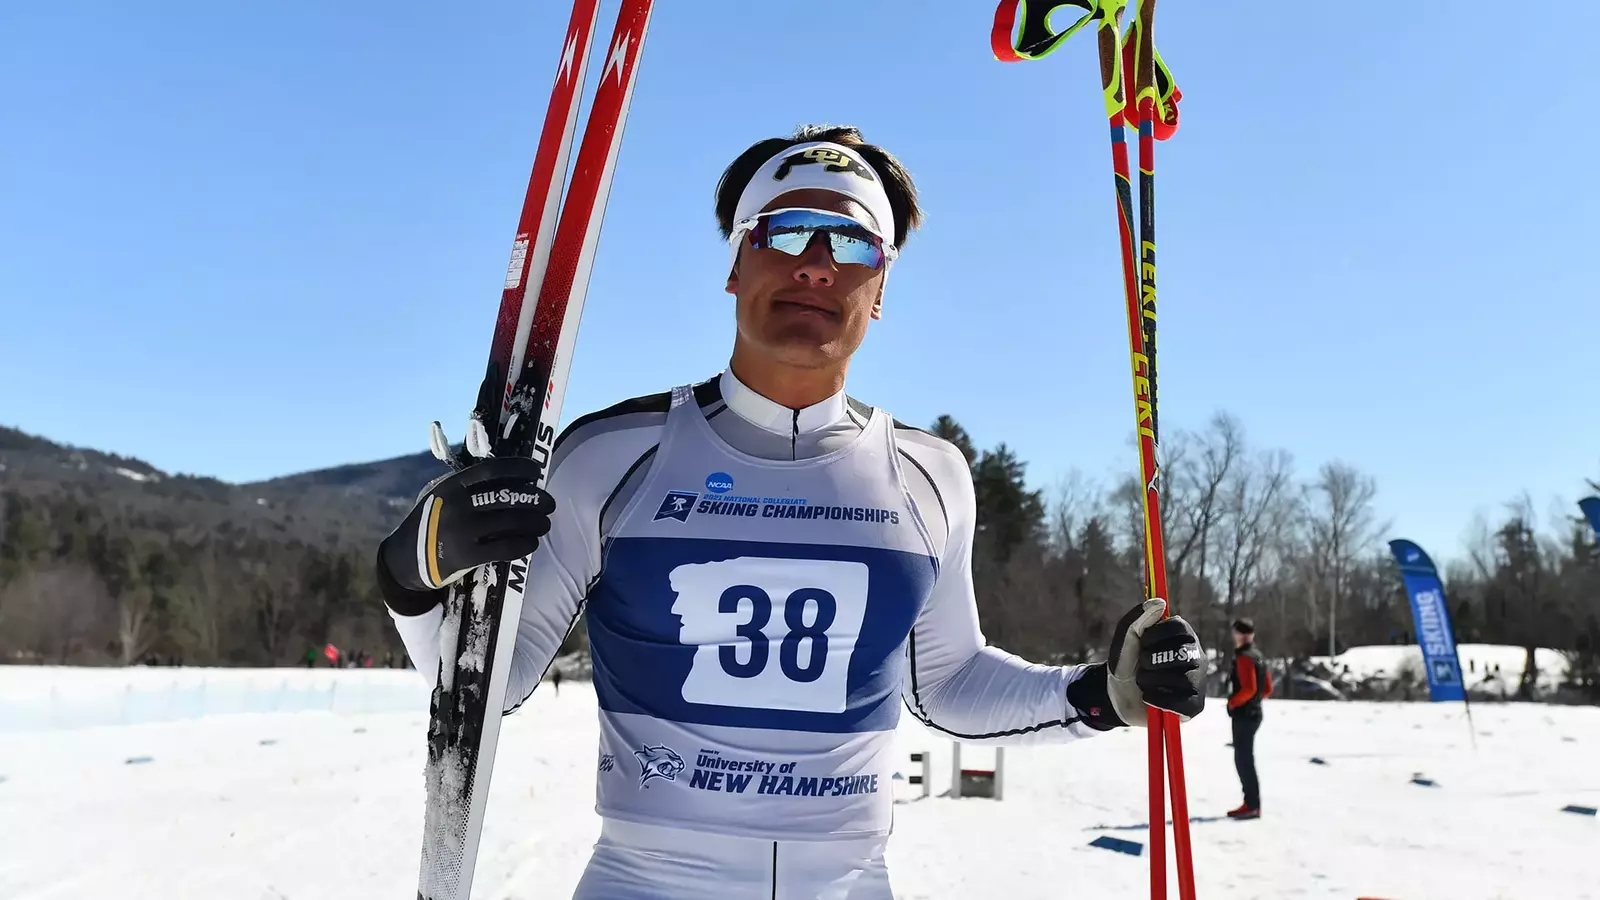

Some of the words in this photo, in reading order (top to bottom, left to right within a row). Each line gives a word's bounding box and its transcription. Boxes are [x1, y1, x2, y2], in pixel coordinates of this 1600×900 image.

[1141, 240, 1157, 322] LEKI
[1133, 351, 1155, 439] LEKI
[707, 480, 732, 489] NCAA
[696, 500, 758, 517] SKIING
[761, 504, 900, 525] CHAMPIONSHIPS
[718, 584, 837, 683] 38
[1415, 591, 1446, 656] SKIING
[689, 769, 753, 793] NEW
[757, 774, 878, 797] HAMPSHIRE
[696, 754, 776, 774] University
[779, 762, 797, 774] of
